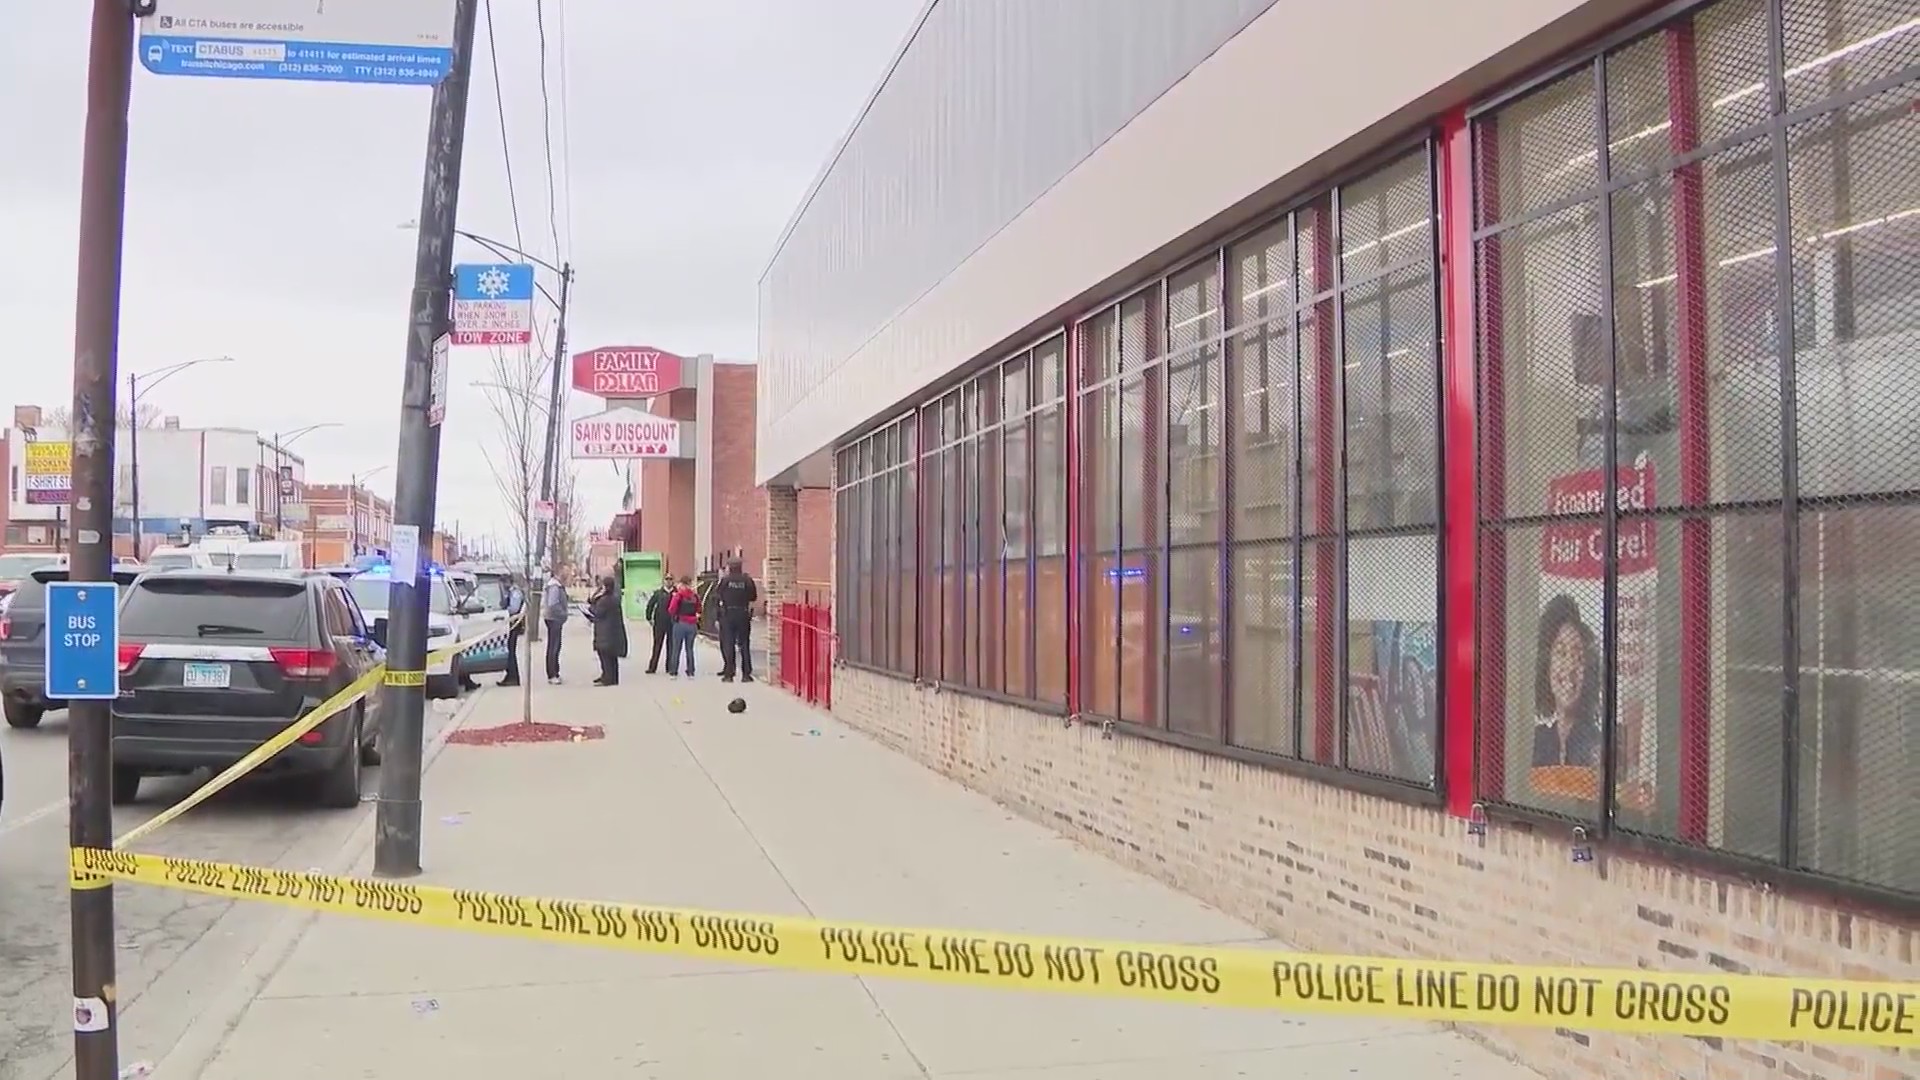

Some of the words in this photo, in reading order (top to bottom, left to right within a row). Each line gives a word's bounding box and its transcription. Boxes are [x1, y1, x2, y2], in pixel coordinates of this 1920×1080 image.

[174, 19, 187, 27] All
[188, 19, 207, 27] CTA
[209, 19, 237, 29] buses
[239, 22, 254, 30] are
[256, 21, 304, 32] accessible
[171, 44, 194, 54] TEXT
[198, 44, 244, 56] CTABUS
[288, 49, 296, 58] to
[298, 49, 325, 59] 41411
[327, 50, 339, 60] for
[341, 51, 385, 62] estimated
[387, 53, 415, 63] arrival
[417, 54, 441, 64] times
[181, 59, 265, 70] transitchicago.com
[278, 63, 301, 74] (312)
[354, 66, 371, 75] TTY
[374, 66, 397, 77] (312)
[473, 302, 507, 310] PARKING
[457, 311, 480, 319] WHEN
[484, 311, 507, 319] SNOW
[511, 311, 519, 319] IS
[457, 320, 478, 328] OVER
[482, 321, 488, 329] 2
[492, 320, 520, 329] INCHES
[457, 332, 484, 343] TOW
[489, 332, 524, 343] ZONE
[593, 352, 660, 371] FAMILY
[593, 372, 659, 392] DOLLAR
[575, 422, 612, 441] SAM'S
[615, 422, 677, 441] DISCOUNT
[1588, 521, 1647, 561] Cre!
[728, 581, 745, 589] POLICE
[68, 615, 96, 629] BUS
[64, 633, 101, 647] STOP
[164, 857, 225, 888] POLICE
[230, 864, 271, 895] LINE
[273, 869, 302, 899] DO
[304, 873, 344, 905] NOT
[350, 878, 423, 915] CROSS
[453, 888, 533, 928] POLICE
[536, 898, 591, 935] LINE
[591, 903, 628, 939] DO
[631, 907, 682, 945] NOT
[690, 914, 779, 955] CROSS
[820, 926, 919, 967] POLICE
[924, 933, 990, 974] LINE
[993, 940, 1035, 978] DO
[1043, 944, 1105, 984] NOT
[1115, 949, 1221, 994] CROSS
[1273, 960, 1385, 1004] POLICE
[1395, 967, 1469, 1010] LINE
[1476, 973, 1520, 1013] DO
[1534, 975, 1603, 1017] NOT
[1614, 979, 1731, 1025] CROSS
[1789, 987, 1917, 1035] POLICE
